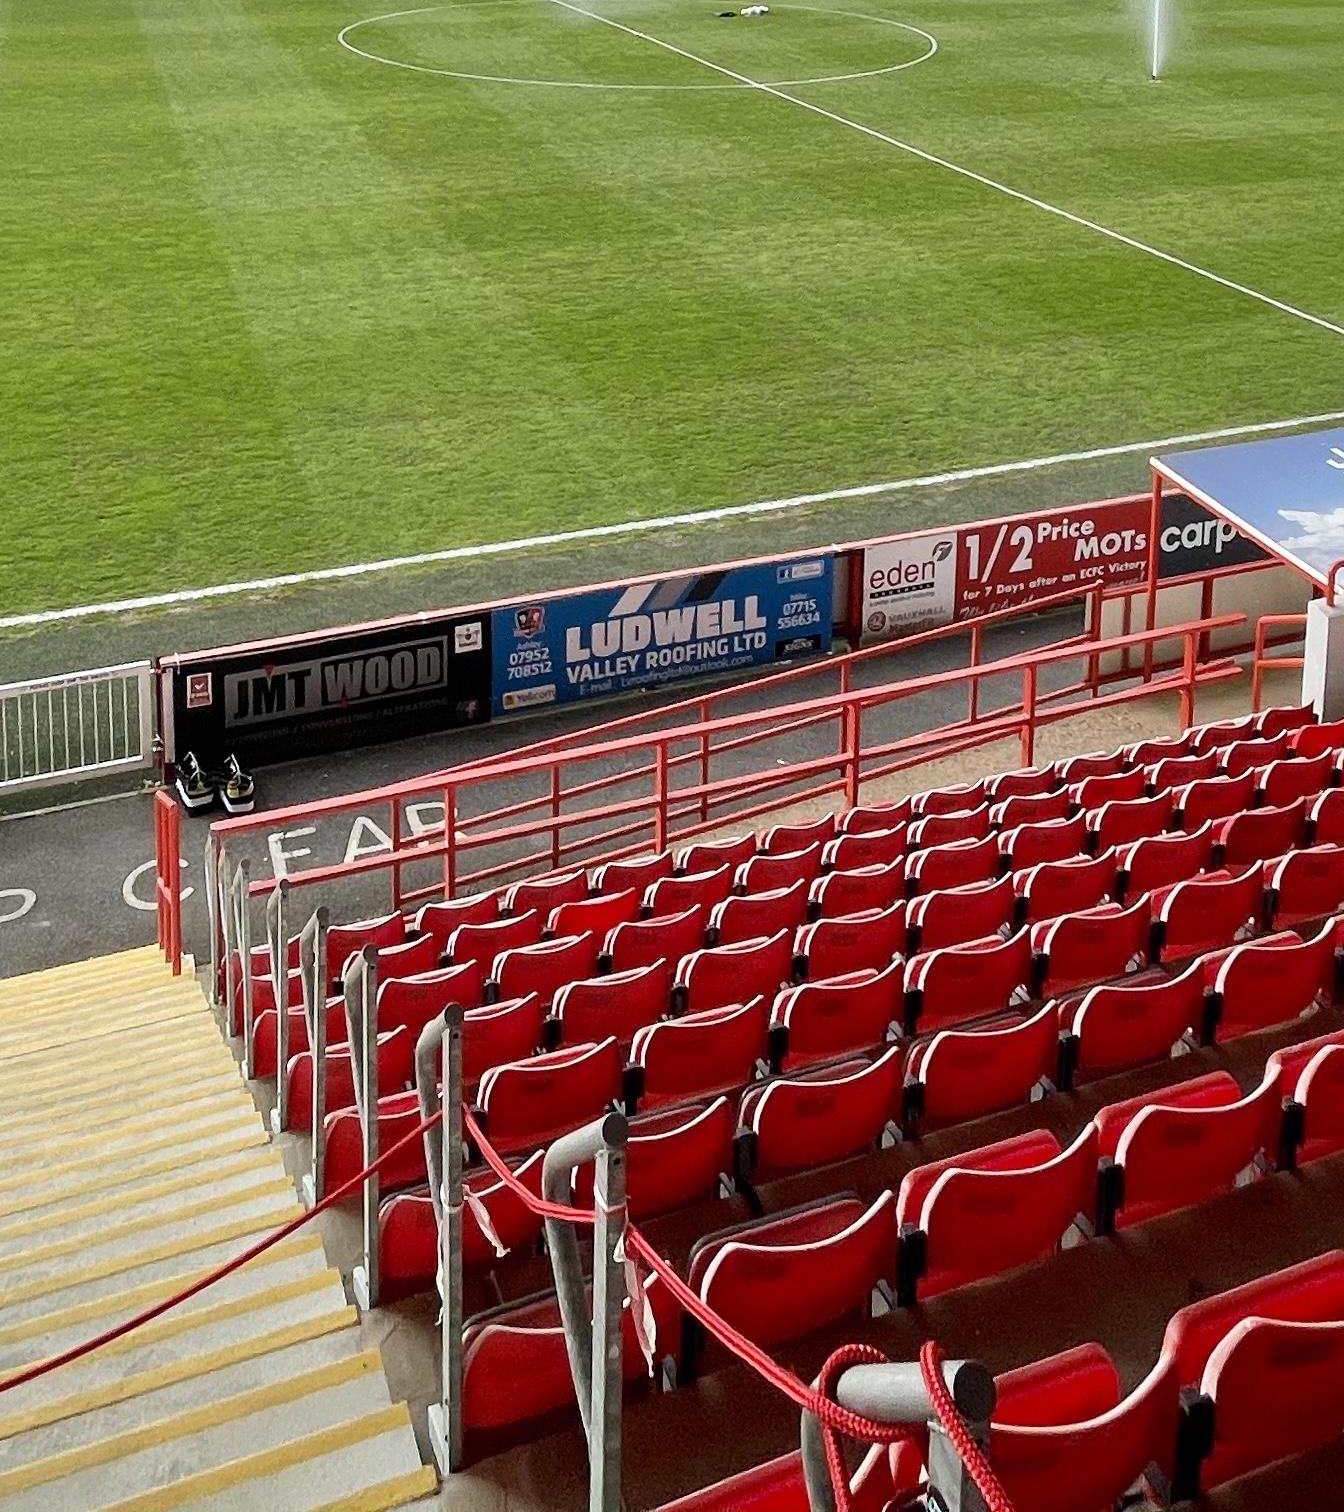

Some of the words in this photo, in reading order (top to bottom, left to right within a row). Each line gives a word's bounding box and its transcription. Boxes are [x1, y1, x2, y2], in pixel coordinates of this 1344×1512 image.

[966, 524, 1034, 583] 1/2
[1036, 518, 1095, 544] Price
[1074, 530, 1147, 561] MOTs
[1158, 519, 1249, 554] carp
[869, 559, 936, 590] eden
[963, 589, 981, 601] for
[985, 587, 993, 597] 7
[996, 582, 1025, 595] Days
[1028, 575, 1059, 589] after
[1062, 572, 1077, 582] an
[1080, 564, 1105, 579] ECFC
[1108, 559, 1147, 575] Victory
[777, 610, 821, 629] 556634
[783, 598, 817, 616] 07715
[565, 594, 767, 664] LUDWELL
[507, 661, 553, 680] 708512
[509, 649, 550, 666] 07952
[567, 655, 645, 684] VALLEY
[645, 639, 730, 670] ROOFING
[732, 631, 767, 654] LTD
[233, 669, 312, 721] JMT
[323, 645, 442, 703] WOOD
[122, 800, 460, 912] CEAR
